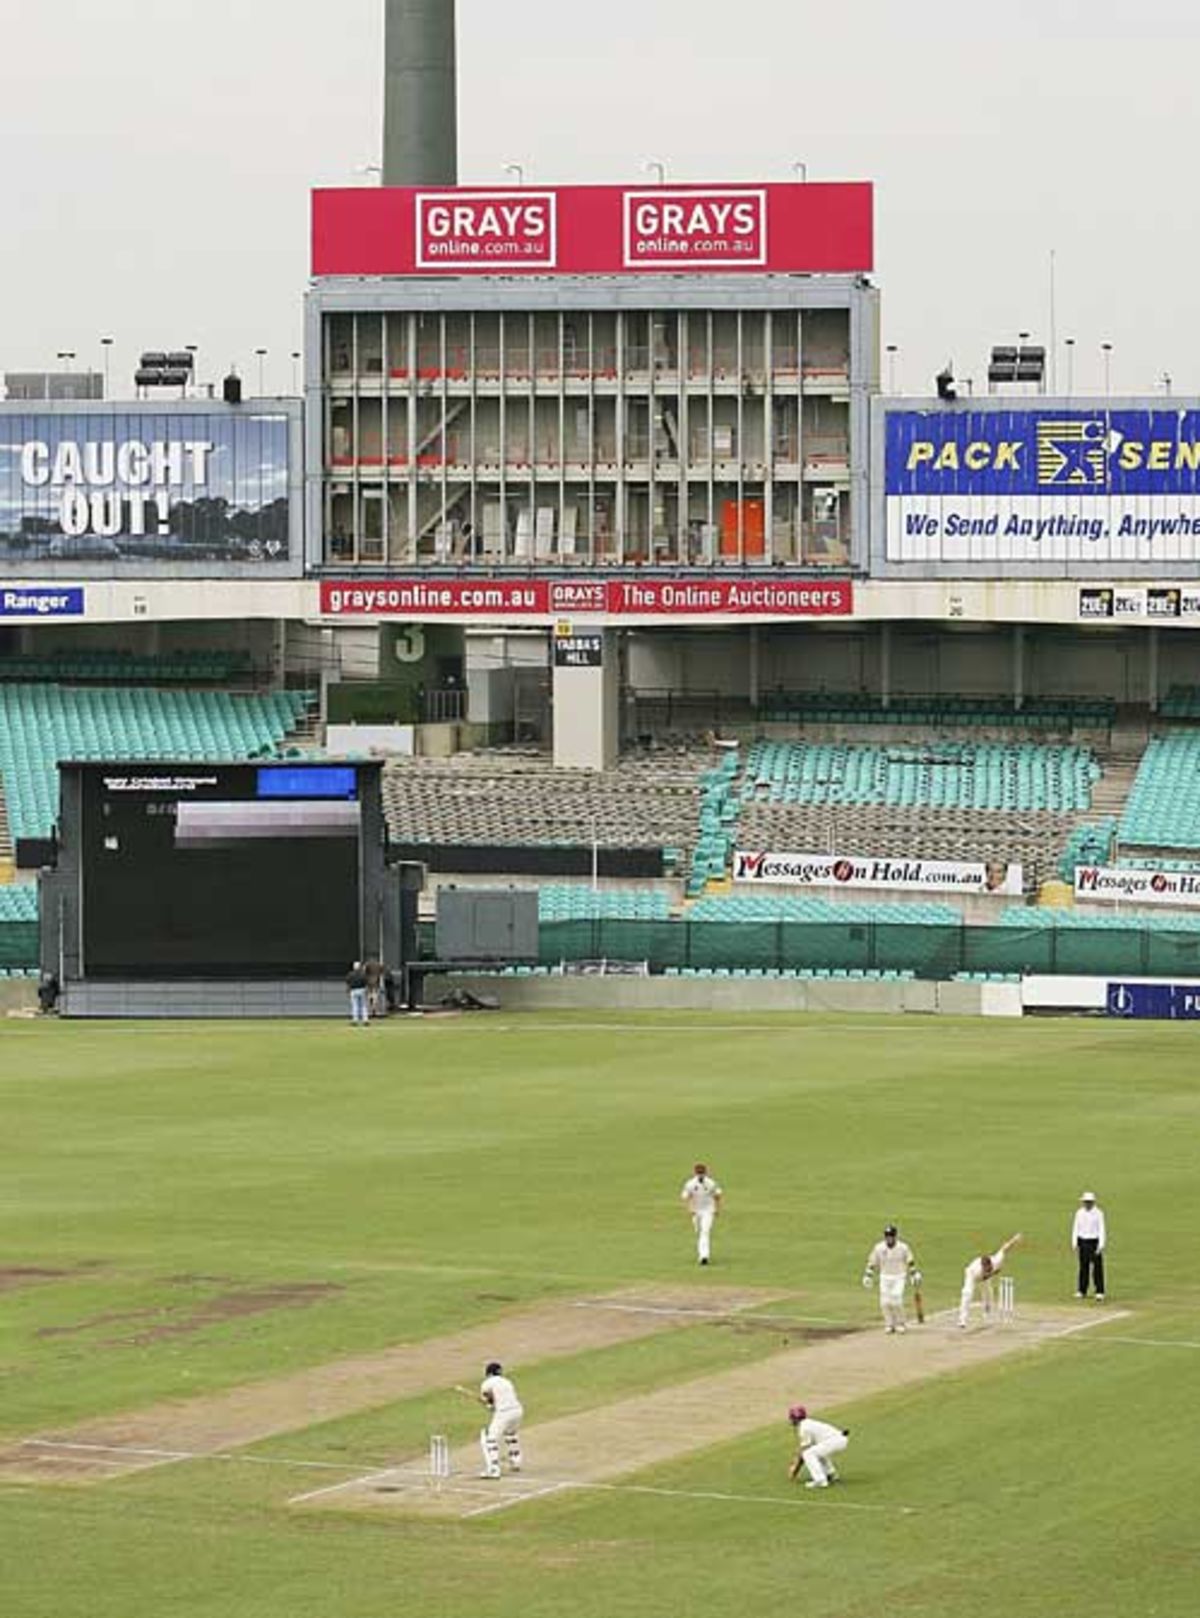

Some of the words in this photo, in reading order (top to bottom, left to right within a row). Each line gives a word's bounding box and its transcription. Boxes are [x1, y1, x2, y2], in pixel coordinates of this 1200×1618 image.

[428, 206, 544, 236] GRAYS
[637, 203, 754, 234] GRAYS
[429, 240, 544, 254] online.com.au
[637, 238, 753, 253] online.com.au
[22, 440, 214, 485] CAUGHT
[906, 442, 1023, 470] PACK
[59, 491, 171, 537] OUT!
[906, 515, 938, 536] We
[945, 514, 998, 535] Send
[1005, 514, 1109, 541] Anything.
[4, 593, 68, 613] Ranger
[330, 585, 536, 611] graysonline.com.au
[554, 586, 604, 600] GRAYS
[623, 586, 655, 605] The
[661, 586, 721, 606] Online
[728, 587, 842, 606] Auctioneers
[396, 624, 425, 662] 3
[738, 851, 832, 882] Messages
[871, 863, 982, 884] Hold.com.au
[1078, 868, 1147, 894] Messages
